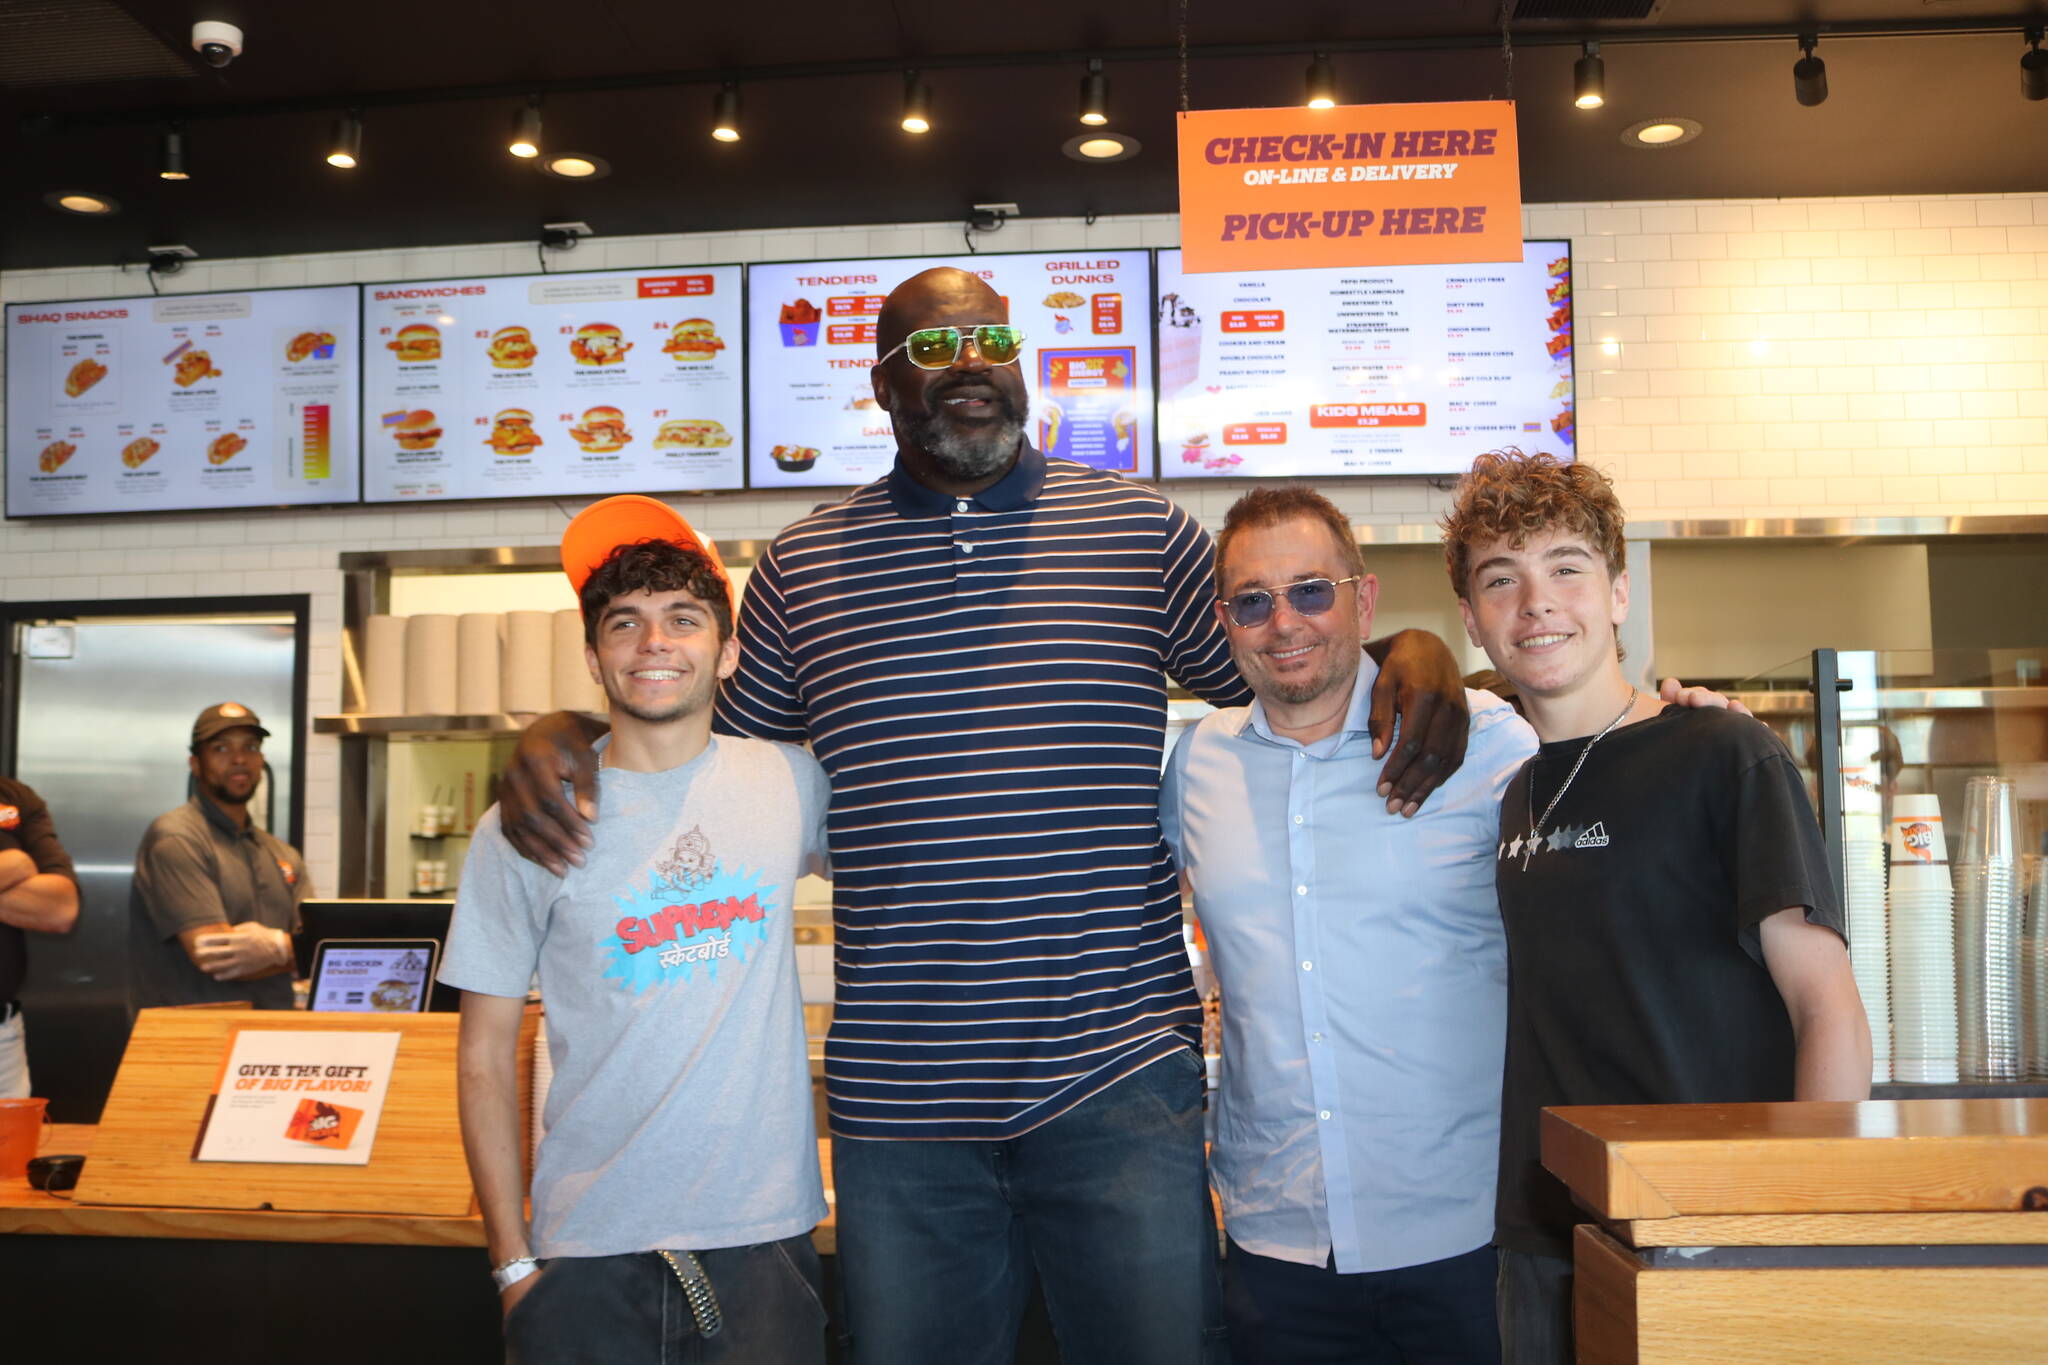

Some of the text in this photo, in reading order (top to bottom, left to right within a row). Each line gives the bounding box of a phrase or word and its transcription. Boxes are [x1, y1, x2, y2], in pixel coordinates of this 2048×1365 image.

[1204, 128, 1498, 165] CHECK-IN HERE
[1243, 162, 1458, 186] ON-LINE & DELIVERY
[1220, 205, 1487, 242] PICK-UP HERE
[1045, 260, 1120, 271] GRILLED
[794, 274, 879, 287] TENDERS
[1051, 274, 1115, 285] DUNKS
[374, 286, 486, 301] SANDWICHES
[17, 308, 129, 325] SHAQ SNACKS
[653, 321, 669, 330] #4
[475, 330, 489, 339] #2
[827, 357, 877, 369] TEND
[653, 409, 669, 418] #7
[1316, 404, 1420, 418] KIDS MEALS
[862, 427, 894, 436] SAL
[1575, 836, 1609, 848] adidas
[616, 892, 766, 955] SUPREME
[656, 931, 733, 969] स्केटबोर्ड
[238, 1064, 369, 1079] GIVE THE GIFT
[234, 1078, 373, 1093] OF BIG FLAVOR!
